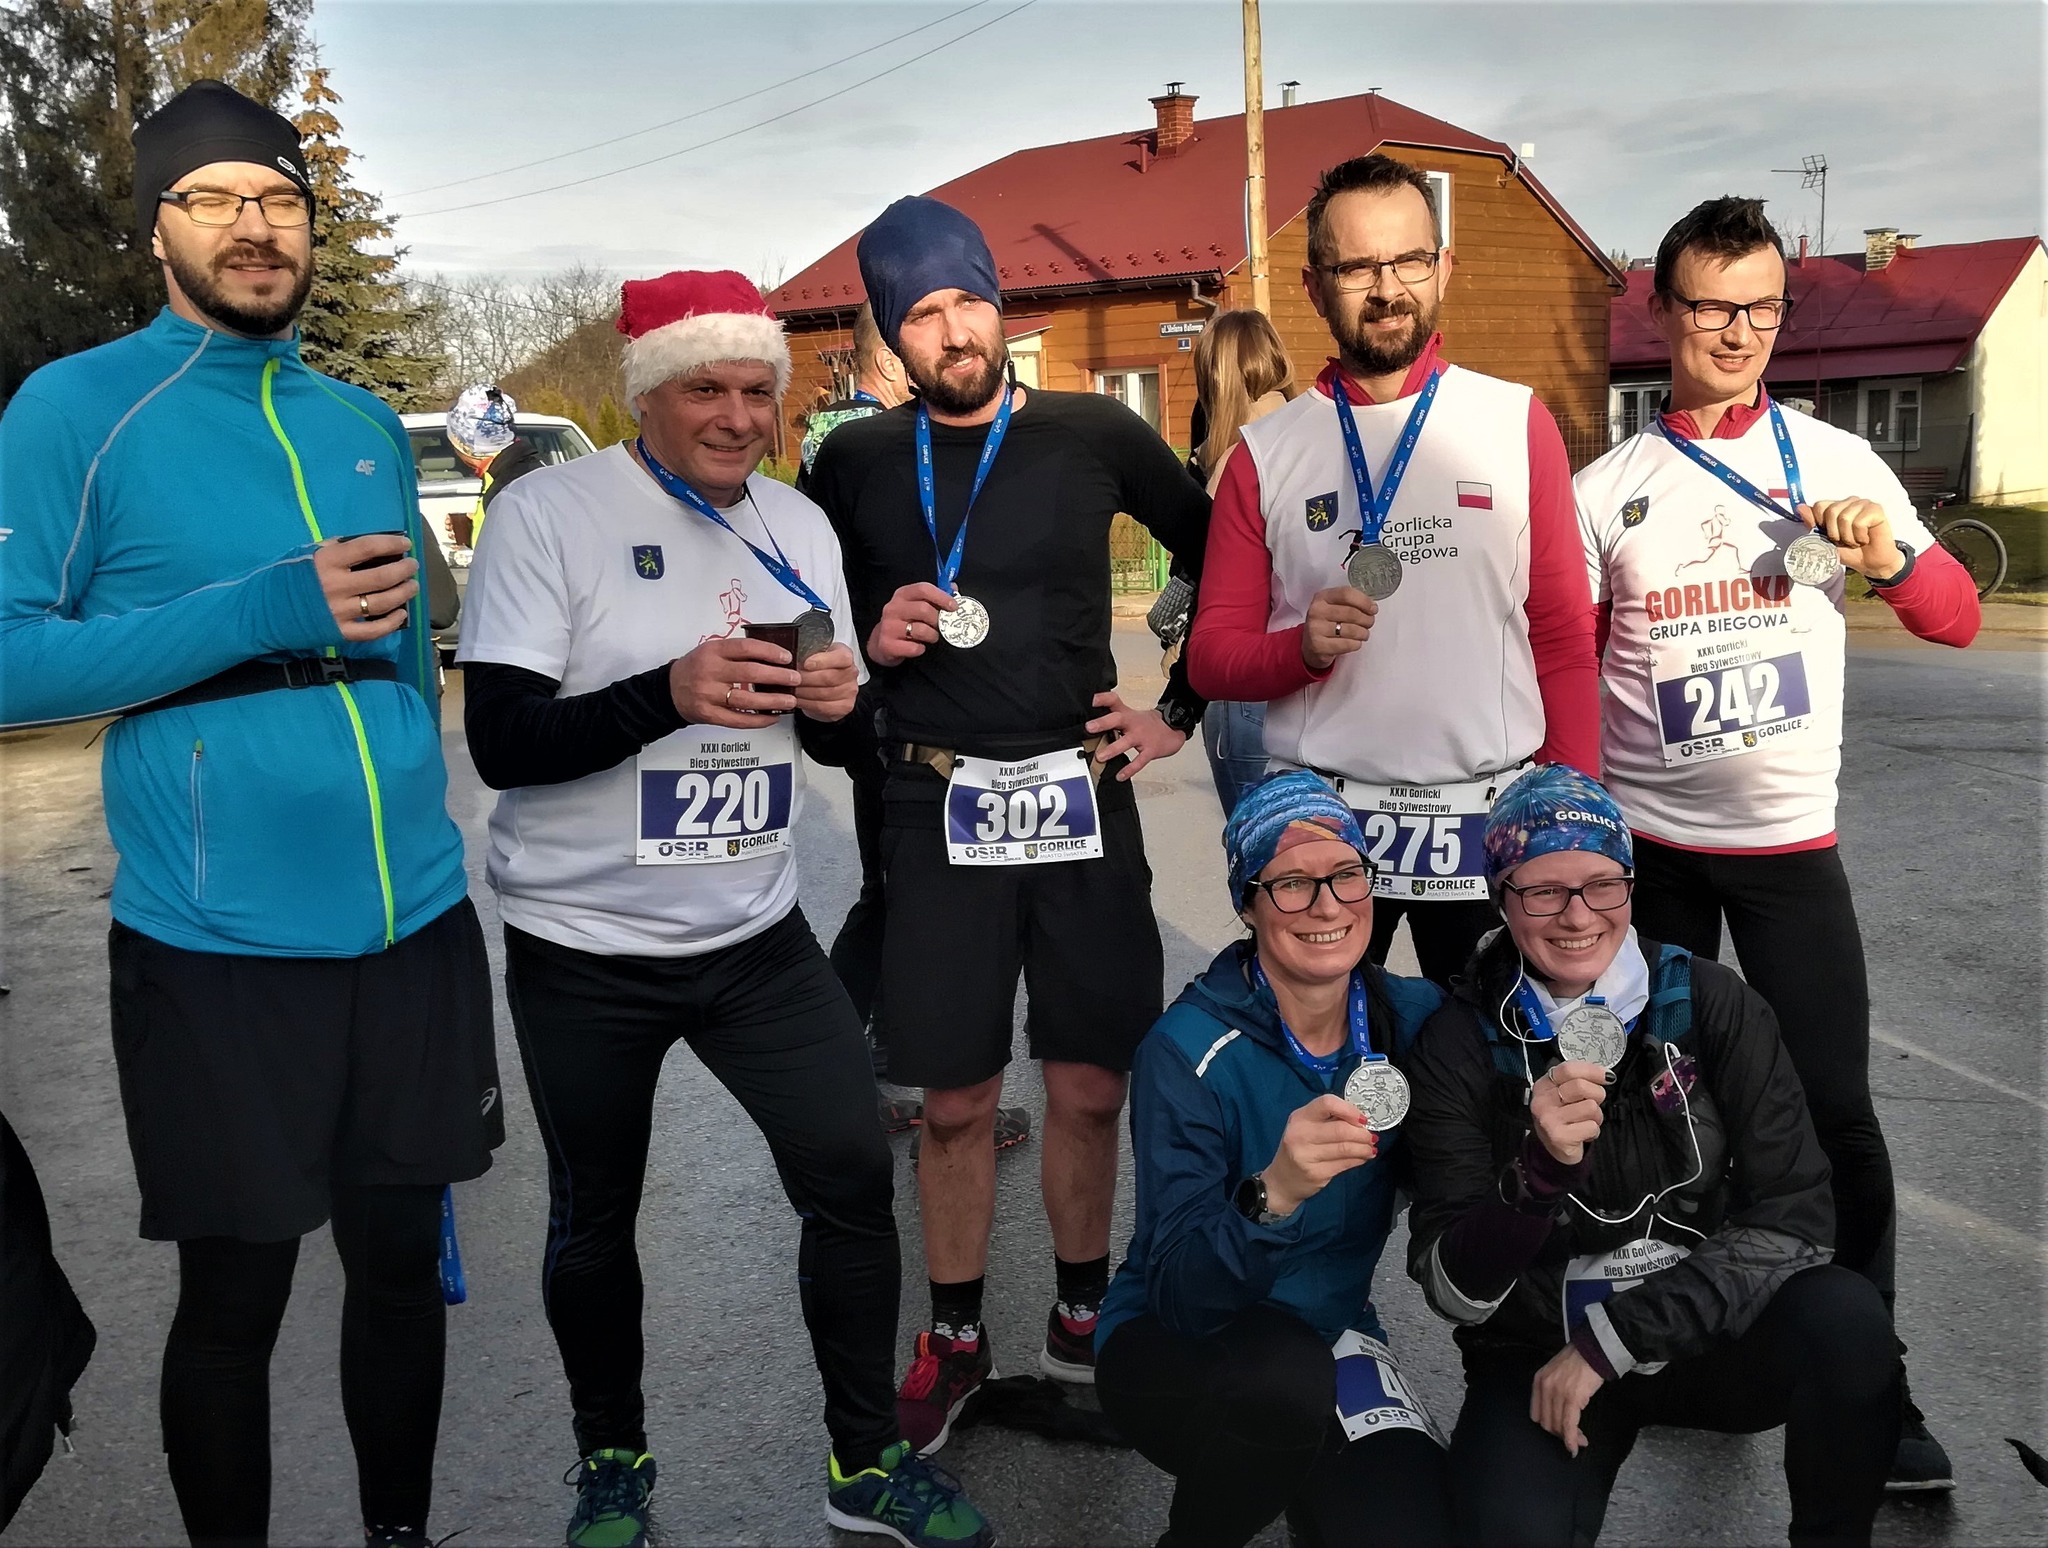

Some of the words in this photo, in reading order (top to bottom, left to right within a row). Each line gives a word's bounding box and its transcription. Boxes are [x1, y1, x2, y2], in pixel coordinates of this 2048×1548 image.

[355, 459, 375, 476] 4F
[1381, 515, 1453, 534] Gorlicka
[1382, 533, 1435, 549] Grupa
[1394, 546, 1458, 565] iegowa
[1645, 574, 1792, 623] GORLICKA
[1649, 622, 1702, 641] GRUPA
[1708, 613, 1788, 633] BIEGOWA
[1697, 646, 1715, 659] XXXI
[1716, 639, 1748, 654] Gorlicki
[1690, 661, 1708, 674] Bieg
[1709, 651, 1762, 670] Sylwestrowy
[1684, 662, 1786, 737] 242
[1758, 719, 1802, 739] GORLICE
[700, 743, 719, 754] XXXI
[721, 742, 751, 753] Gorlicki
[690, 758, 709, 769] Bieg
[711, 757, 759, 769] Sylwestrowy
[999, 766, 1015, 776] XXXI
[1017, 761, 1039, 775] Gorlicki
[991, 779, 1006, 790] Bieg
[1008, 773, 1049, 789] Sylwestrowy
[1389, 787, 1408, 797] XXXI
[1409, 788, 1441, 799] Gorlicki
[676, 769, 769, 836] 220
[1379, 800, 1397, 811] Bieg
[1399, 802, 1451, 813] Sylwestrowy
[976, 784, 1069, 842] 302
[1555, 810, 1617, 832] GORLICE
[741, 832, 779, 848] GORLICE
[1039, 839, 1087, 852] GORLICE
[1365, 814, 1461, 875] 275
[1427, 879, 1476, 890] GORLICE
[1612, 1248, 1630, 1260] XXXI
[1603, 1265, 1623, 1277] Bieg
